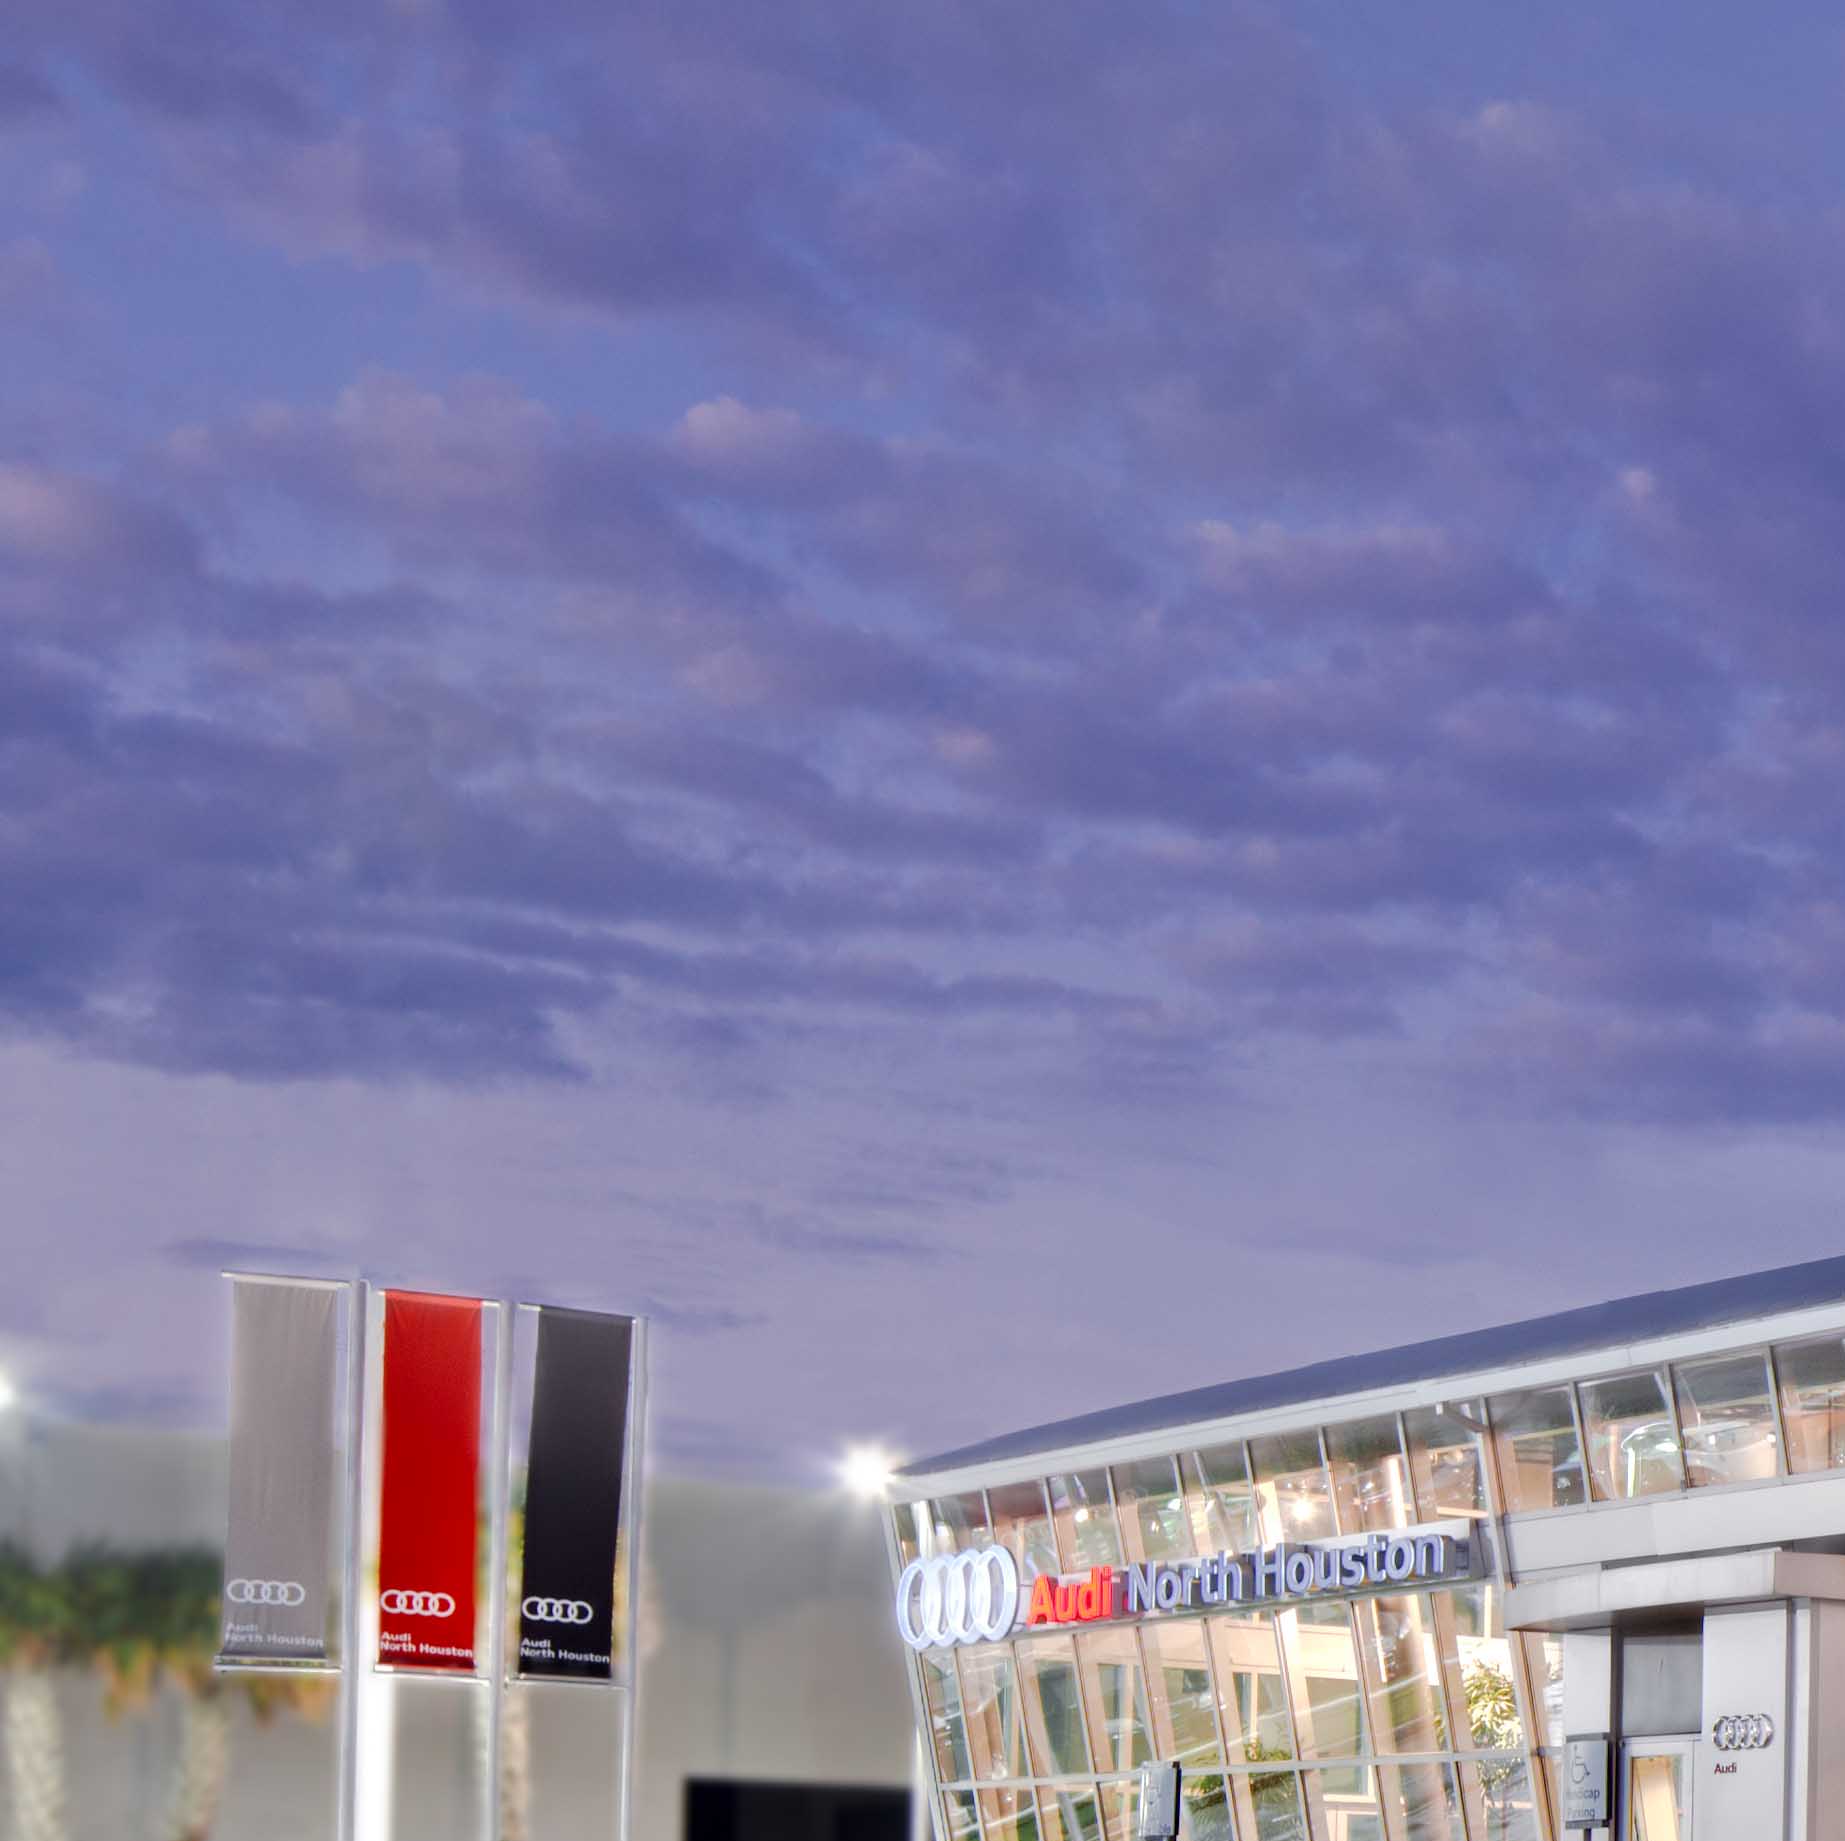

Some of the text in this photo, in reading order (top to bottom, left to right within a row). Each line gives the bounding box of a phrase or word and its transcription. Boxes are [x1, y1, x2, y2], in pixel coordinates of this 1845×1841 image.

[1026, 1534, 1450, 1626] Audi North Houston
[381, 1631, 412, 1642] Audi
[521, 1637, 552, 1649] Audi
[380, 1640, 474, 1658] North Houston
[520, 1646, 610, 1664] North Houston
[1713, 1762, 1738, 1775] Audi
[1565, 1786, 1601, 1803] dicap
[1566, 1807, 1597, 1822] Pking
